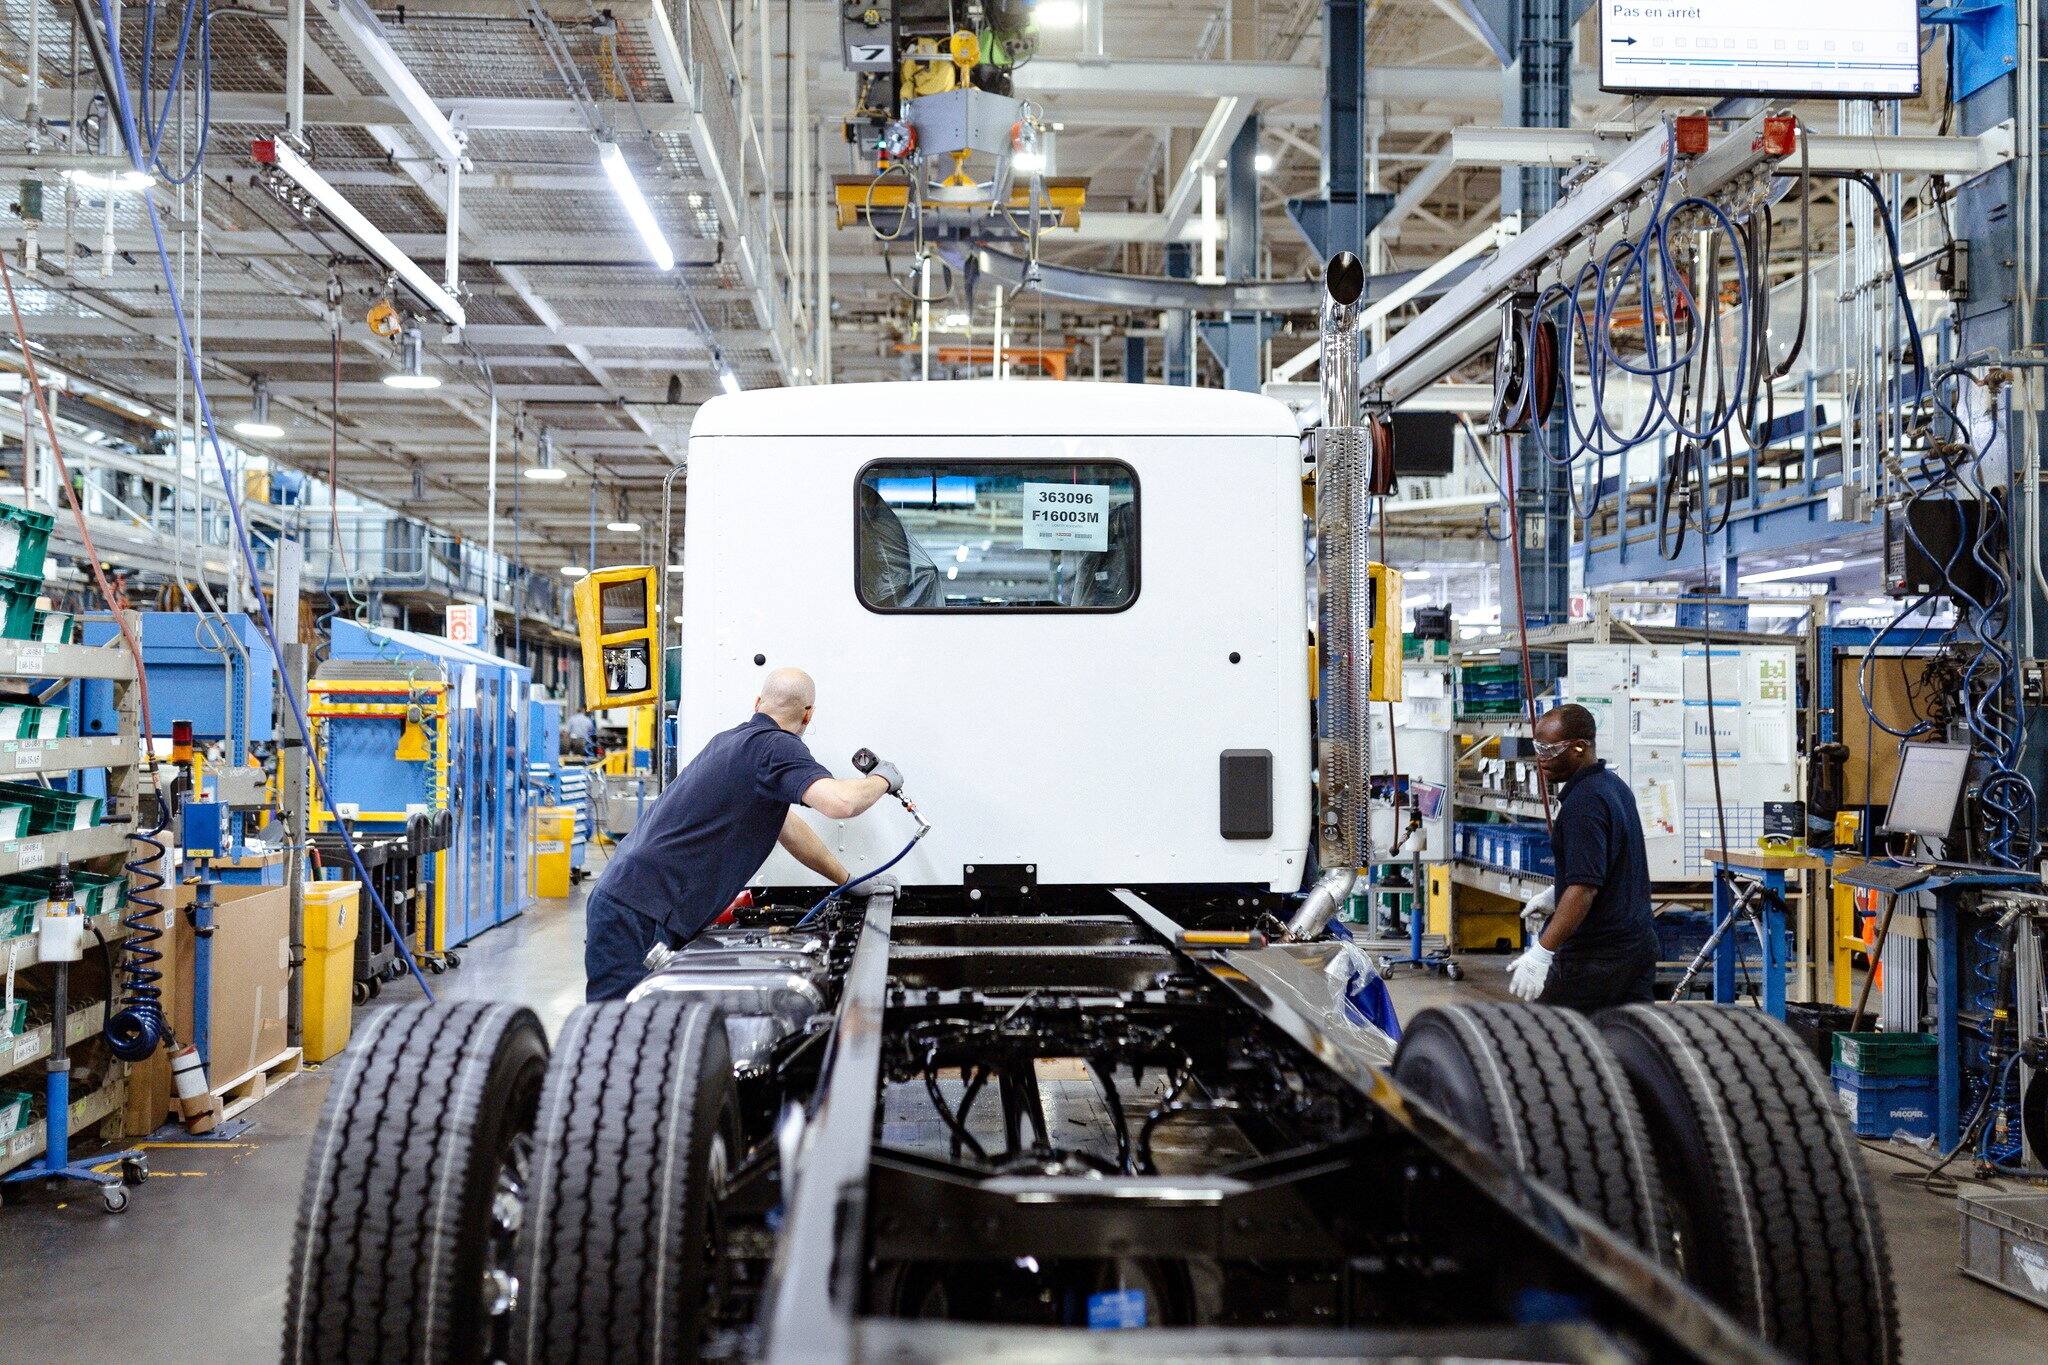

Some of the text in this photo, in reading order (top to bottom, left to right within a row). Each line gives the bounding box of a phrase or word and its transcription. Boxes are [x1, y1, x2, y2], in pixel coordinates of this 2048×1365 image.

[1613, 4, 1701, 18] Pas en arrêt
[860, 48, 885, 60] 7
[1038, 491, 1094, 505] 363096
[1032, 510, 1099, 523] F16003M
[1531, 516, 1540, 530] N
[1532, 531, 1539, 547] 8
